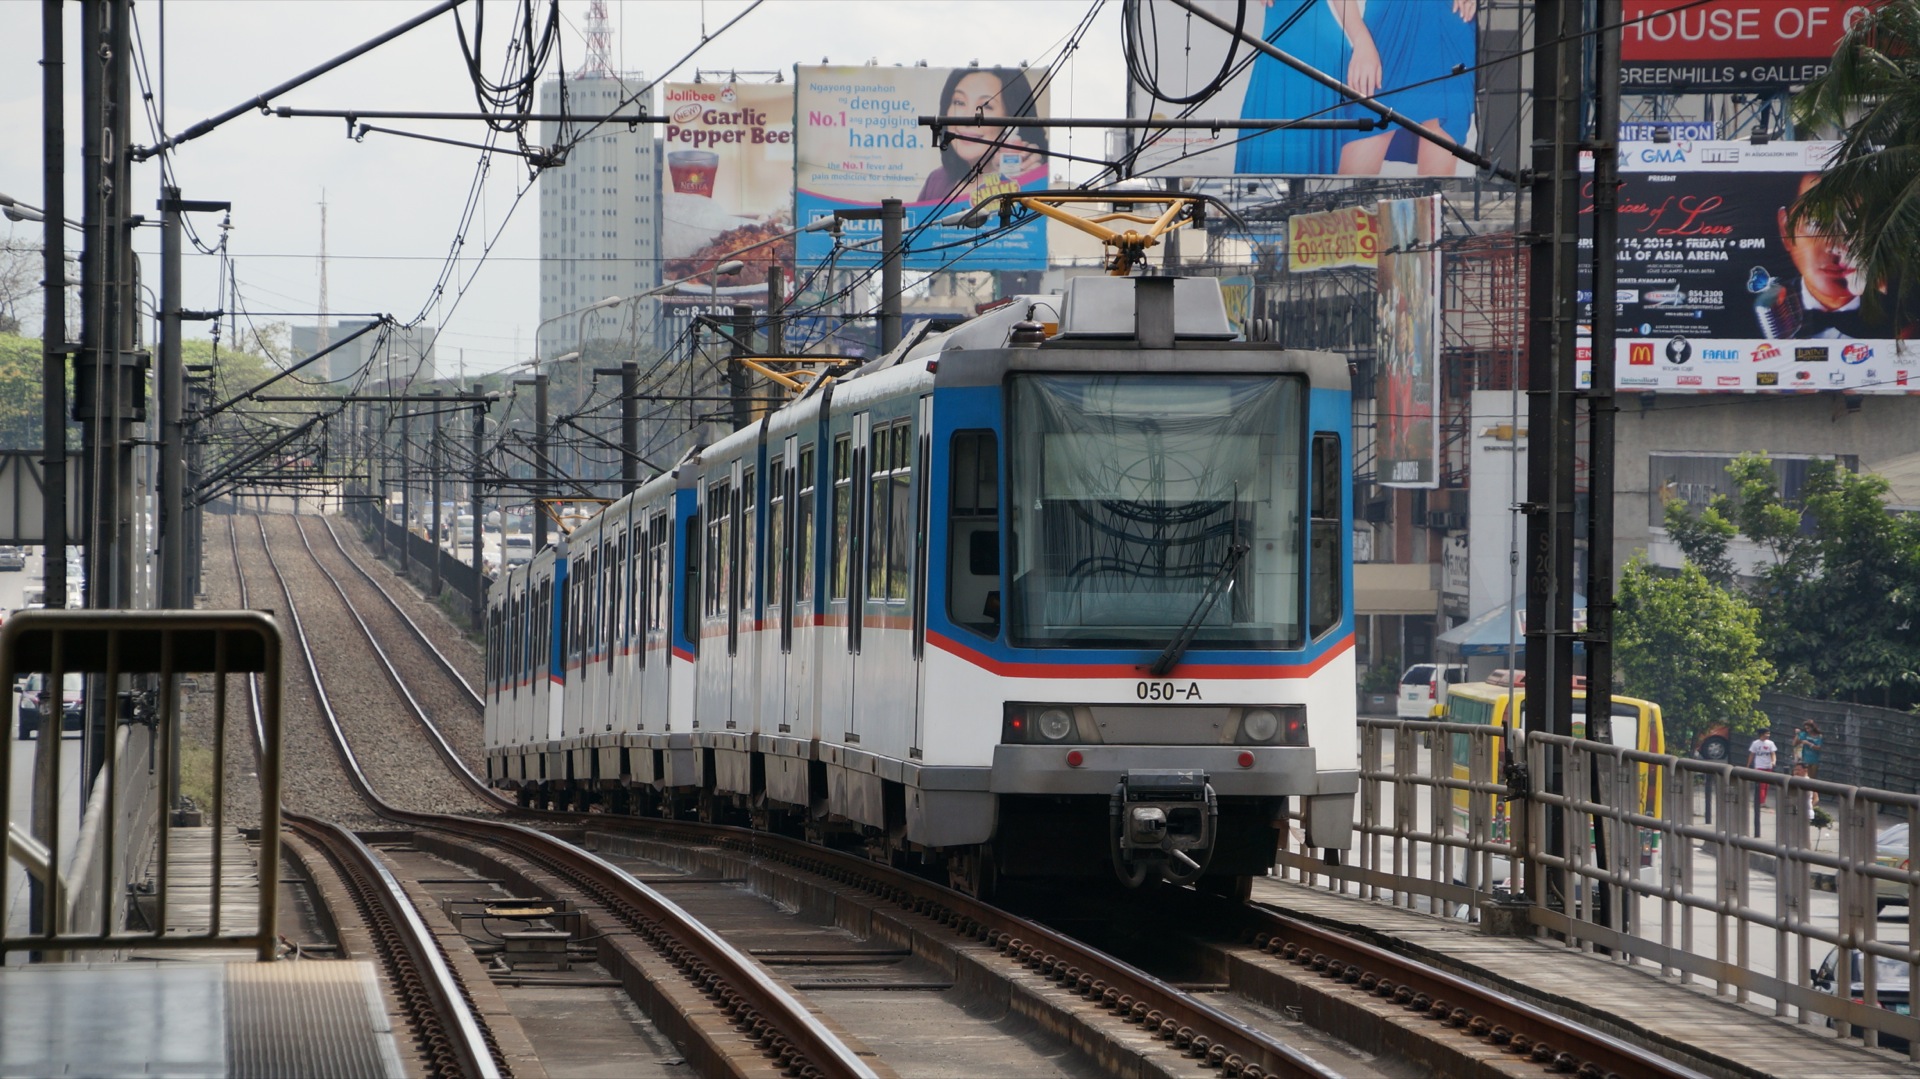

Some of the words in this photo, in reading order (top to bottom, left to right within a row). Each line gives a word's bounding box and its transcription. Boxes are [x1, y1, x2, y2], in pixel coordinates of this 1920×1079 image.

[1620, 7, 1760, 42] HOUSE
[1774, 6, 1830, 40] OF
[1619, 66, 1735, 85] GREENHILLS
[1752, 65, 1831, 82] GALLER
[666, 89, 716, 102] Jollibee
[809, 82, 852, 94] Ngayong
[854, 83, 896, 94] panahon
[676, 105, 699, 120] NEW!
[850, 96, 916, 115] dengue,
[702, 107, 767, 126] Garlic
[809, 110, 847, 127] No.1
[864, 115, 918, 130] pagiging
[666, 125, 746, 149] Pepper
[751, 126, 795, 144] Bee
[849, 127, 924, 149] handa.
[1640, 148, 1686, 163] GMA
[842, 161, 865, 170] No.1
[1656, 195, 1735, 235] Love
[1643, 237, 1674, 249] 2014
[1685, 237, 1726, 249] FRIDAY
[1739, 237, 1766, 249] 8PM
[1635, 251, 1652, 261] OF
[1655, 251, 1684, 261] ASIA
[1686, 251, 1729, 261] ARENA
[1750, 347, 1782, 363] Zim
[1136, 681, 1203, 701] 050-A
